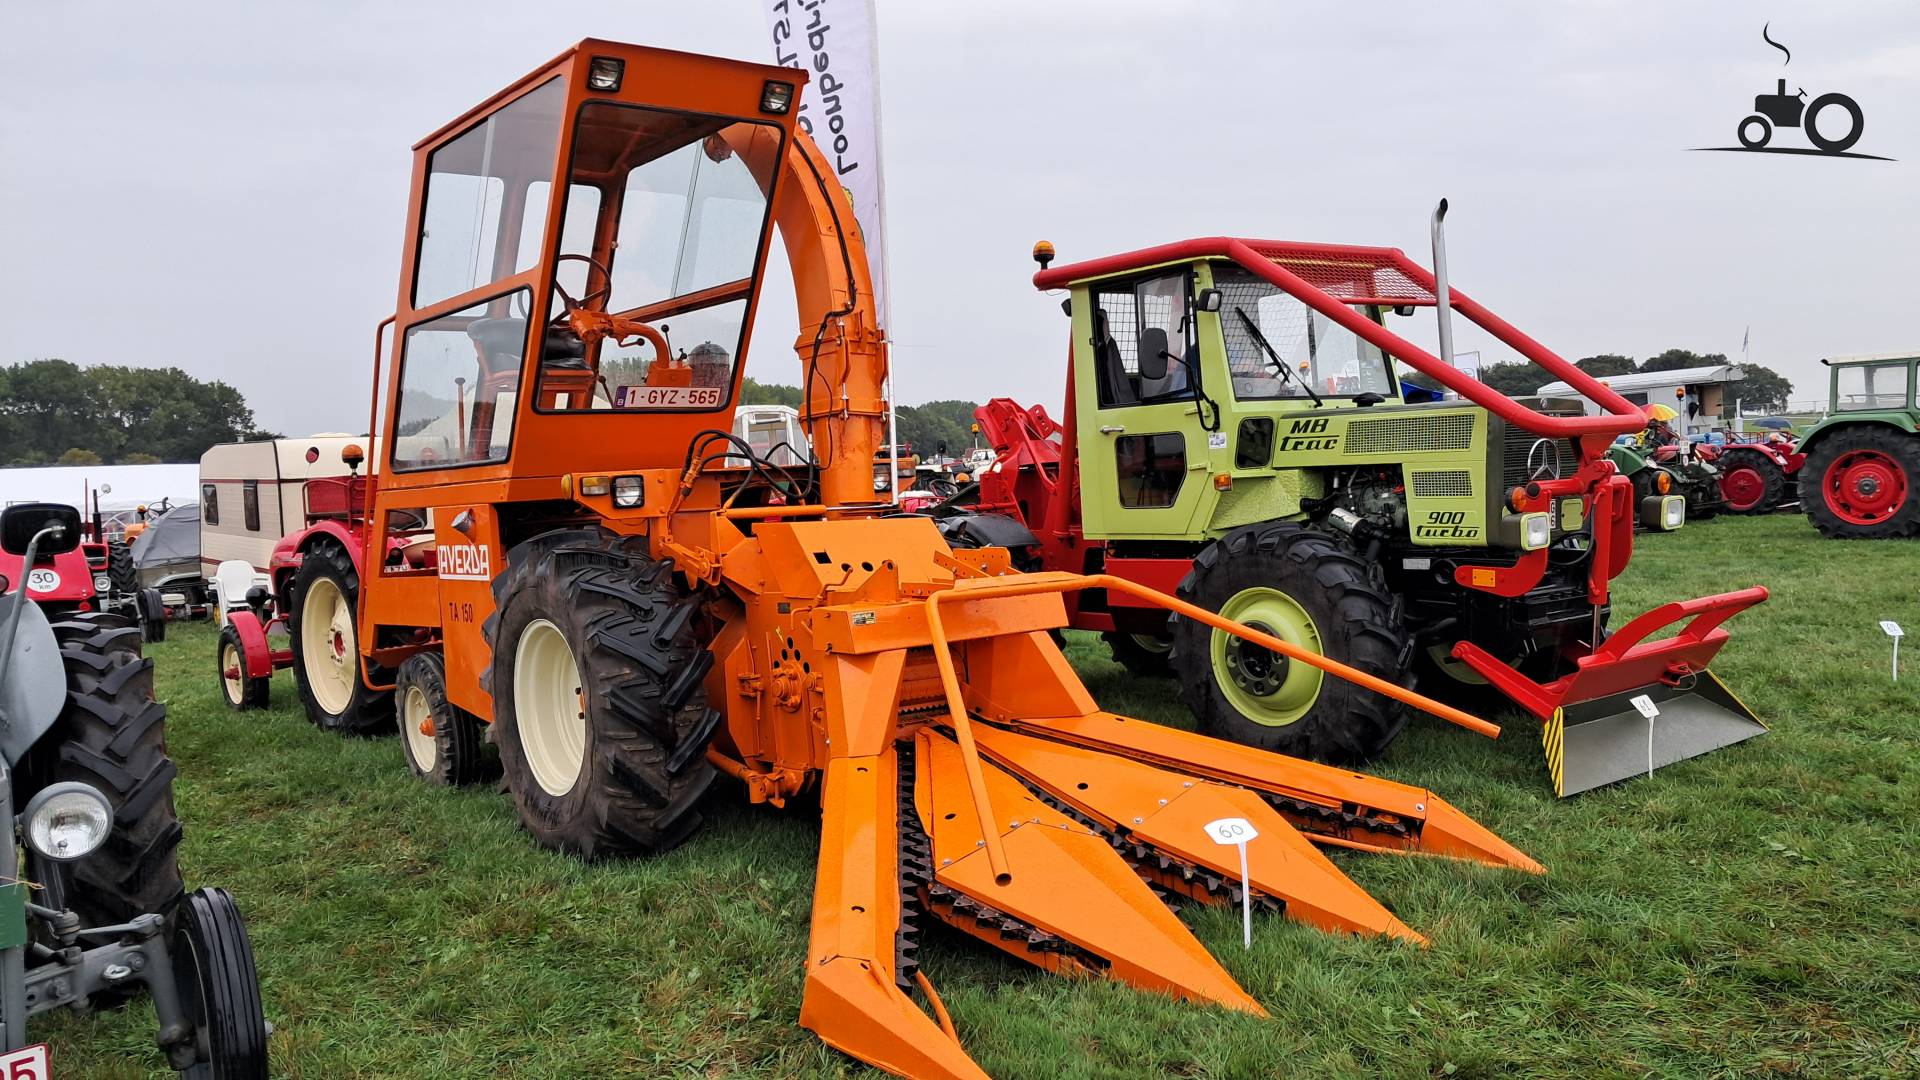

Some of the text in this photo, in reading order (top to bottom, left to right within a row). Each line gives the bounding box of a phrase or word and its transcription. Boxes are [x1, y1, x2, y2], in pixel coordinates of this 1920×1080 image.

[1290, 418, 1330, 434] MB
[1280, 434, 1339, 452] trac
[1426, 511, 1466, 525] 900
[1416, 525, 1480, 538] turbo
[32, 572, 55, 584] 30
[449, 602, 474, 623] TA 150
[1219, 824, 1245, 839] 60
